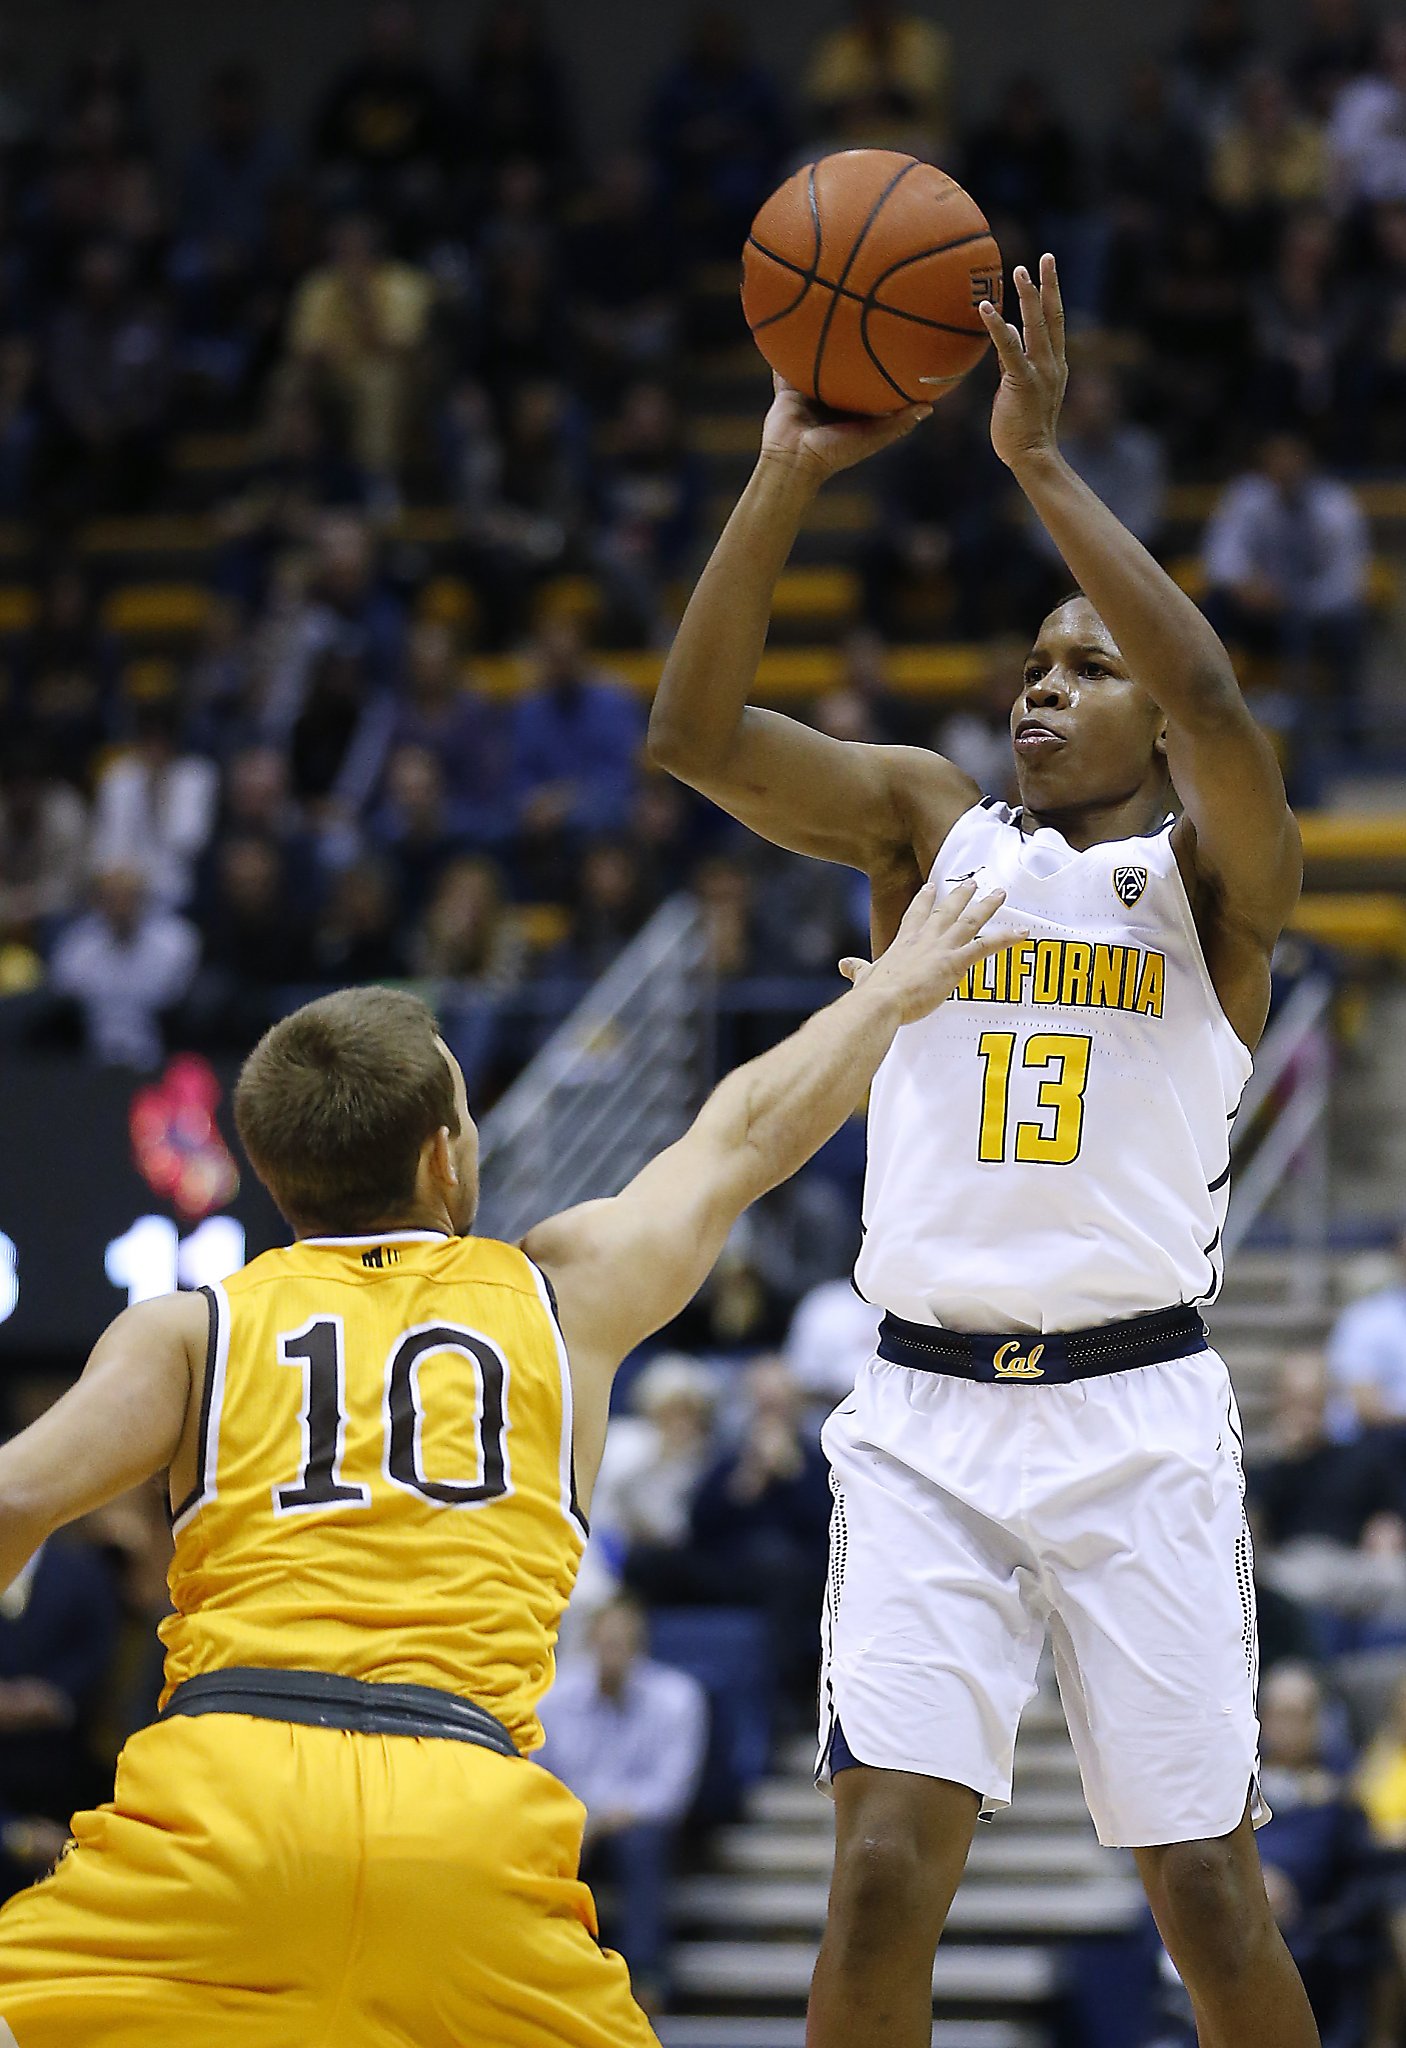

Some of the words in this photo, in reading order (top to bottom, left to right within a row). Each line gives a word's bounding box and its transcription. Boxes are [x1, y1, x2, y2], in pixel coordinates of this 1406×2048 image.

[1115, 867, 1146, 892] PAC
[1121, 883, 1138, 899] 12
[946, 938, 1166, 1019] LIFORNIA
[977, 1031, 1093, 1165] 13
[993, 1341, 1045, 1379] Cal
[272, 1314, 515, 1517] 10
